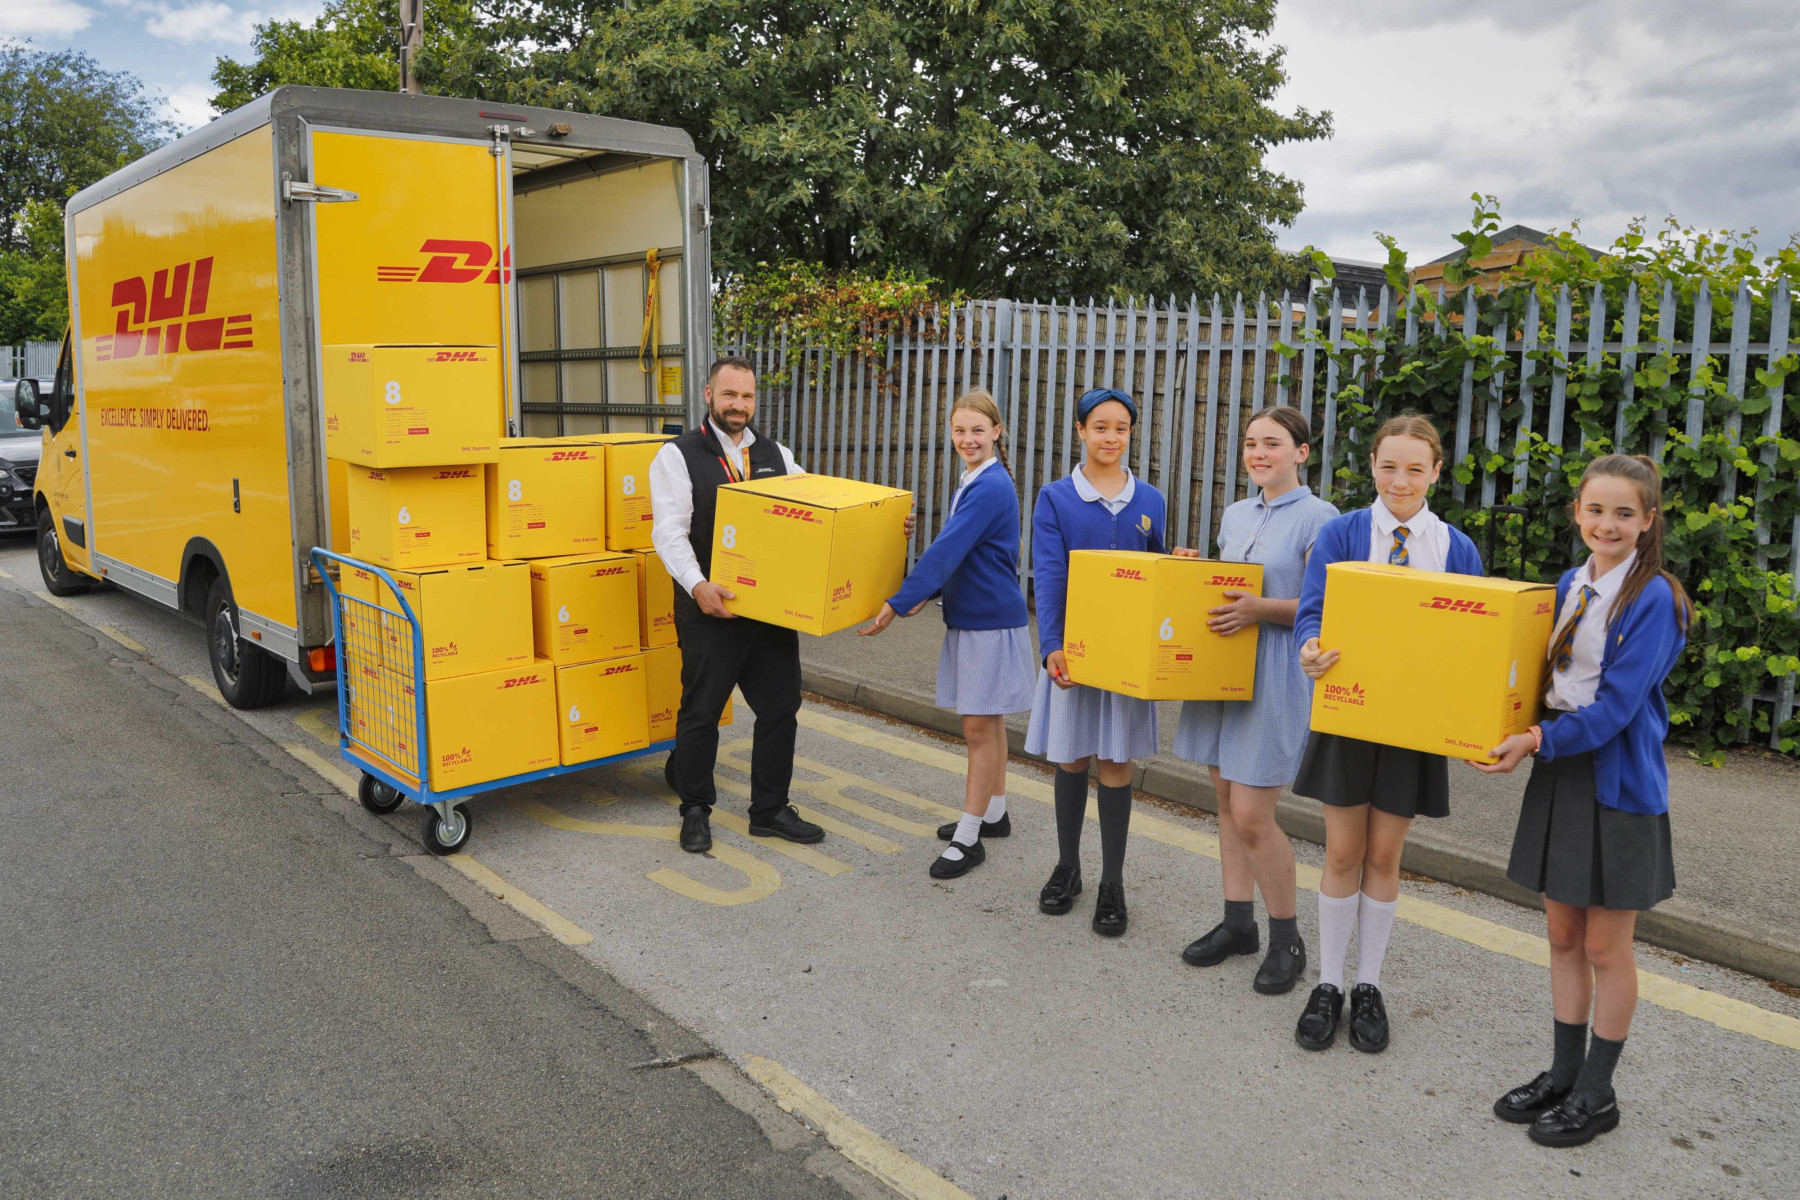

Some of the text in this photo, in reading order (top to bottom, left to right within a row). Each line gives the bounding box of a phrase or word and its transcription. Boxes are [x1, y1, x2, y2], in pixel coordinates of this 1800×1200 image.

[111, 256, 225, 360] DHL
[350, 352, 367, 363] DHL
[435, 351, 480, 362] DHL
[384, 380, 402, 404] 8
[101, 408, 211, 432] EXCELLENCE. SIMPLY DELIVERED.
[473, 445, 491, 453] Express
[551, 450, 590, 462] DHL
[439, 470, 472, 479] DHL
[507, 479, 523, 501] 8
[622, 474, 636, 495] 8
[397, 506, 411, 524] 6
[771, 504, 816, 523] DHL
[721, 523, 737, 549] 8
[595, 567, 624, 577] DHL
[1115, 567, 1142, 581] DHL
[397, 580, 413, 590] DHL
[1210, 575, 1247, 587] DHL
[1430, 596, 1488, 616] DHL
[558, 605, 570, 622] 6
[784, 609, 814, 621] DHL Express
[1158, 617, 1174, 641] 6
[432, 646, 449, 654] 100%
[605, 664, 633, 676] DHL
[1508, 659, 1518, 689] 6
[503, 674, 540, 689] DHL
[1324, 684, 1351, 696] 100%
[1323, 693, 1365, 706] RECYCLABLE
[568, 705, 581, 723] 6
[651, 712, 665, 720] 100%
[1444, 737, 1484, 751] DHL Express
[441, 752, 461, 763] 100%
[442, 757, 473, 767] RECYCLABLE
